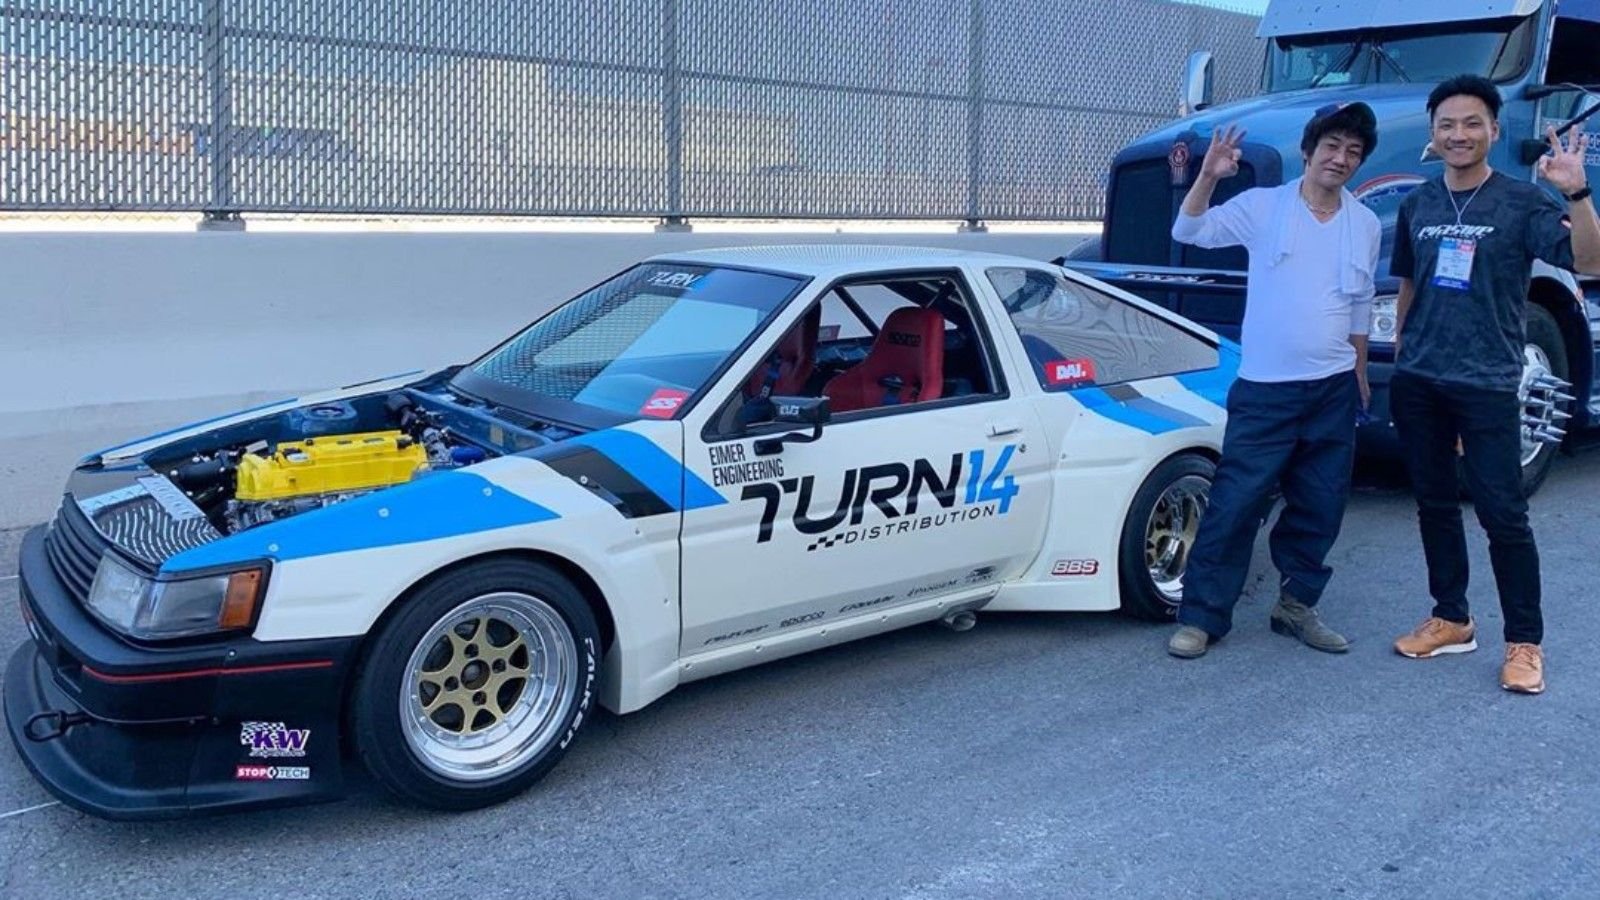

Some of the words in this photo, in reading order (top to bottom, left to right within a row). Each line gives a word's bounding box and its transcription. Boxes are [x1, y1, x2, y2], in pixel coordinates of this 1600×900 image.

[709, 443, 746, 466] EIMER
[712, 458, 785, 487] ENGINEERING
[844, 504, 995, 545] DISTRIBUTION
[1052, 559, 1099, 576] BBS
[560, 636, 596, 750] FALKEN
[251, 729, 310, 751] KW
